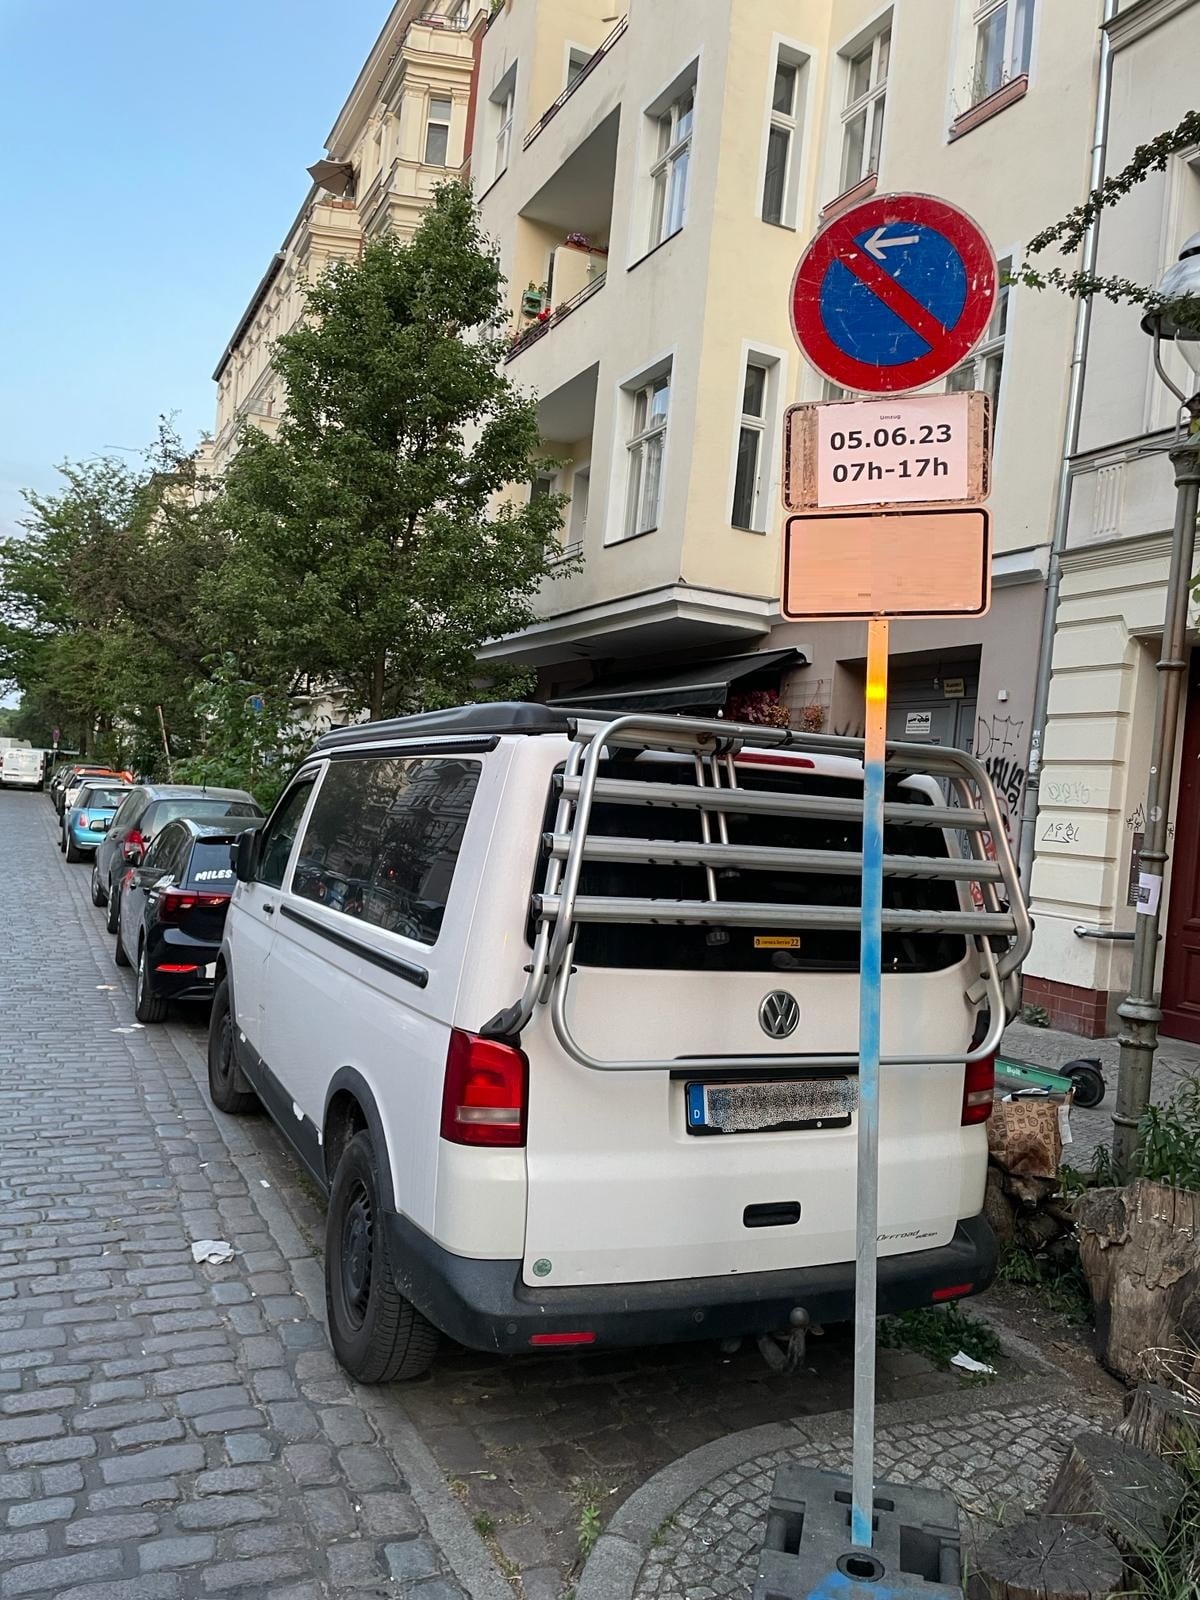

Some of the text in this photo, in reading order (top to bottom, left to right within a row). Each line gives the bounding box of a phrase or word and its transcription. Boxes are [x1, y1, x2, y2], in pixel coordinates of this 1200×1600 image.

[830, 424, 952, 450] 05.06.23
[832, 457, 948, 482] 07h-17h
[195, 869, 233, 881] MILES
[694, 1109, 701, 1119] D
